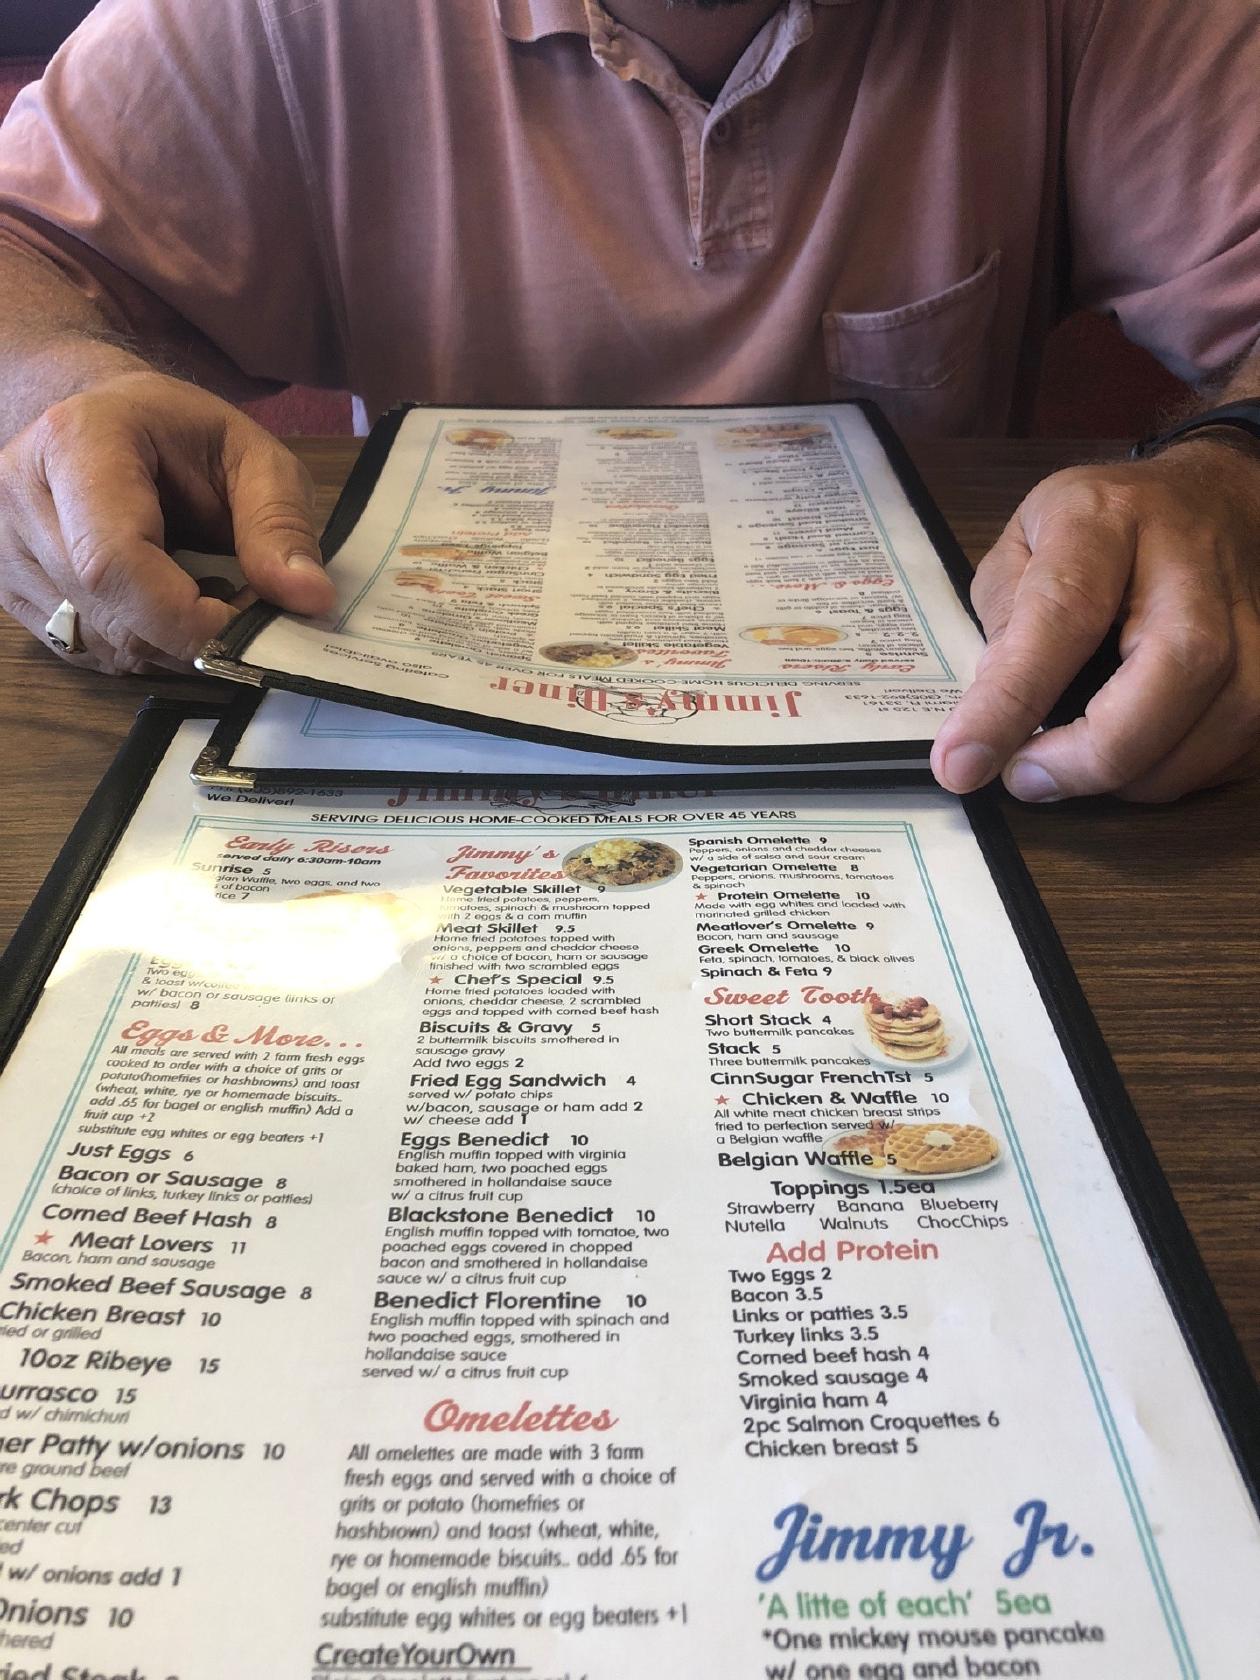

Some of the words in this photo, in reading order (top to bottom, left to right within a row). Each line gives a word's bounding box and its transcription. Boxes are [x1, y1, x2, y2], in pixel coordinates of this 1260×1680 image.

[620, 603, 666, 611] Special
[668, 603, 704, 611] Chef's
[620, 642, 659, 650] Skillet
[664, 640, 729, 648] Vegetable
[323, 648, 380, 667] Services
[431, 652, 472, 662] YEARS
[386, 664, 449, 679] Catering
[402, 662, 432, 670] also
[496, 665, 533, 674] OVER
[858, 661, 915, 672] Early
[537, 670, 564, 678] FOR
[569, 674, 612, 684] MEALS
[617, 677, 723, 686] HOME-COOKED
[802, 679, 861, 687] SERVING
[489, 676, 608, 712] Diner
[624, 689, 802, 719] Jimmy's
[207, 793, 232, 802] We
[236, 794, 294, 806] Deliver!
[311, 814, 378, 822] SERVING
[469, 814, 591, 823] HOME-COOKED
[592, 812, 642, 823] MEALS
[648, 814, 677, 822] FOR
[683, 812, 724, 821] OVER
[225, 836, 295, 855] Early
[304, 840, 390, 854] Risers
[689, 837, 743, 847] Spanish
[747, 836, 810, 844] Omelette
[446, 846, 560, 864] Jimmy's
[445, 865, 567, 880] Favorites
[691, 864, 767, 874] Vegetarian
[772, 863, 837, 871] Omelette
[444, 885, 527, 896] Vegetable
[533, 885, 581, 894] Skillet
[718, 891, 768, 900] Protein
[773, 891, 840, 899] Omelette
[436, 923, 482, 933] Meat
[487, 923, 538, 933] Skillet
[555, 925, 575, 933] 9.5
[697, 921, 782, 931] Meatlover's
[787, 921, 856, 930] Omelette
[698, 944, 744, 954] Greek
[749, 943, 819, 952] Omelette
[835, 944, 850, 952] 10
[701, 966, 762, 979] Spinach
[785, 967, 817, 976] Feta
[455, 974, 510, 984] Chef's
[517, 973, 582, 988] Special
[593, 976, 614, 984] 9.5
[704, 987, 790, 1005] Sweet
[800, 986, 878, 1005] Tooth
[705, 1014, 753, 1026] Short
[760, 1012, 811, 1025] Stack
[121, 1020, 199, 1049] Eggs
[420, 1021, 490, 1033] Biscuits
[497, 1022, 511, 1033] &
[518, 1021, 573, 1035] Gravy
[592, 1023, 600, 1032] 5
[734, 1028, 792, 1036] buttermilk
[796, 1027, 854, 1038] pancakes
[708, 1041, 760, 1054] Stack
[410, 1074, 458, 1087] Fried
[466, 1075, 501, 1090] Egg
[509, 1074, 606, 1087] Sandwich
[626, 1076, 636, 1086] 4
[711, 1072, 814, 1088] CinnSugar
[820, 1070, 911, 1083] FrenchTst
[743, 1092, 822, 1105] Chicken
[830, 1092, 846, 1104] &
[851, 1090, 917, 1104] Waffle
[931, 1093, 949, 1103] 10
[714, 1109, 729, 1118] All
[734, 1109, 768, 1118] white
[773, 1109, 806, 1117] meat
[810, 1108, 858, 1117] chicken
[863, 1108, 902, 1117] breast
[907, 1108, 940, 1117] strips
[401, 1132, 450, 1151] Eggs
[458, 1131, 549, 1146] Benedict
[571, 1135, 588, 1145] 10
[67, 1142, 114, 1158] Just
[118, 1145, 171, 1164] Eggs
[184, 1151, 194, 1161] 6
[718, 1152, 798, 1170] Belgian
[804, 1150, 876, 1168] Waffle
[58, 1165, 129, 1182] Bacon
[136, 1172, 161, 1184] or
[165, 1171, 263, 1192] Sausage
[276, 1178, 287, 1189] 8
[770, 1181, 869, 1200] Toppings
[881, 1180, 935, 1194] 1.5ea
[727, 1201, 814, 1215] Strawberry
[837, 1200, 904, 1212] Banana
[920, 1198, 998, 1212] Blueberry
[42, 1204, 129, 1222] Corned
[133, 1208, 189, 1225] Beef
[192, 1211, 251, 1228] Hash
[266, 1216, 277, 1229] 8
[388, 1206, 509, 1222] Blackstone
[517, 1207, 613, 1223] Benedict
[637, 1210, 655, 1222] 10
[725, 1219, 785, 1233] Nutella
[819, 1216, 888, 1230] Walnuts
[917, 1214, 1008, 1230] ChocChips
[69, 1231, 135, 1250] Meat
[140, 1235, 213, 1253] Lovers
[232, 1242, 246, 1254] 11
[766, 1240, 825, 1263] Add
[837, 1238, 938, 1261] Protein
[728, 1270, 765, 1283] Two
[772, 1269, 815, 1285] Eggs
[821, 1267, 832, 1280] 2
[10, 1272, 114, 1292] Smoked
[119, 1277, 177, 1295] Beef
[180, 1279, 286, 1304] Sausage
[300, 1286, 312, 1300] 8
[731, 1289, 788, 1302] Bacon
[796, 1287, 823, 1301] 3.5
[374, 1291, 479, 1309] Benedict
[486, 1291, 601, 1309] Florentine
[627, 1294, 646, 1308] 10
[0, 1301, 97, 1322] Chicken
[105, 1305, 186, 1325] Breast
[201, 1312, 221, 1327] 10
[20, 1348, 79, 1369] 10oz
[85, 1350, 172, 1376] Ribeye
[200, 1358, 220, 1374] 15
[423, 1399, 620, 1432] Omelettes
[755, 1503, 975, 1583] Jimmy
[1003, 1499, 1095, 1579] Jr.
[859, 1590, 887, 1618] of
[996, 1588, 1052, 1616] 5ea
[829, 1627, 909, 1654] mickey
[918, 1629, 997, 1648] mouse
[1004, 1621, 1104, 1651] pancake
[314, 1642, 515, 1667] CreateYourOwn
